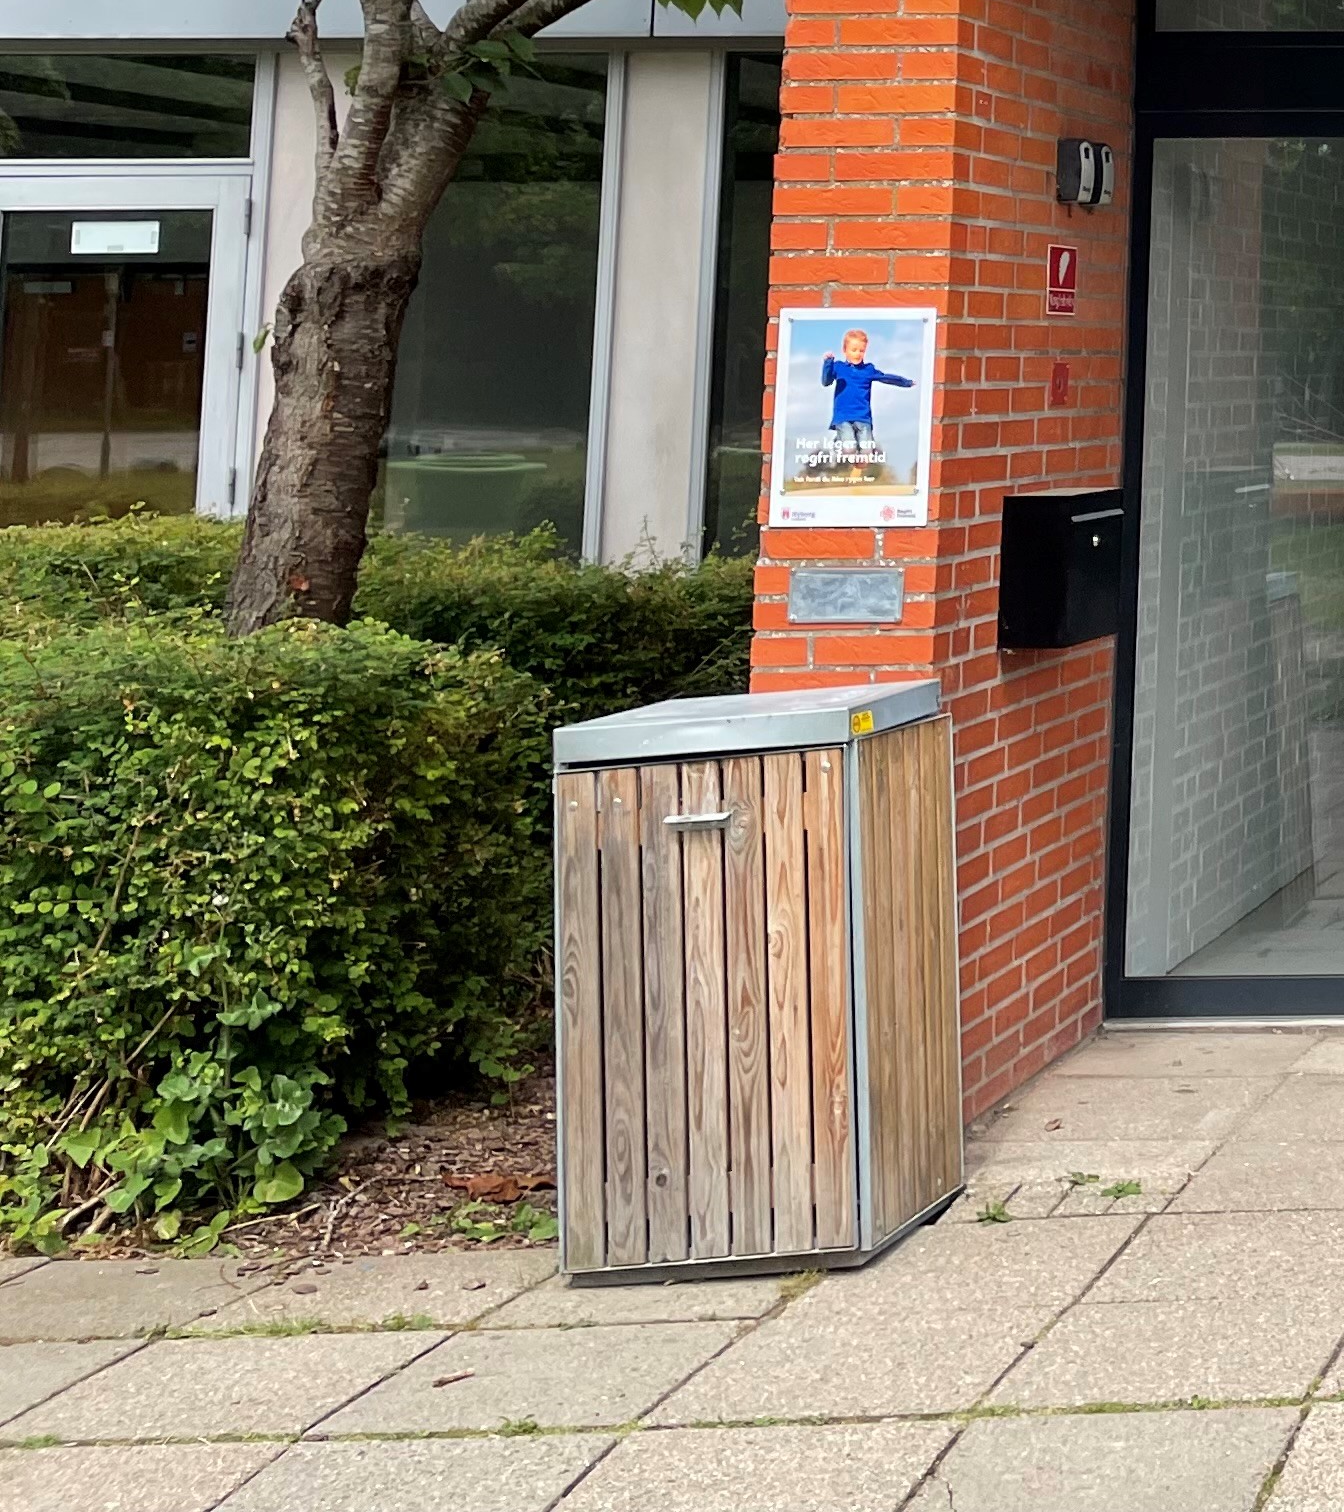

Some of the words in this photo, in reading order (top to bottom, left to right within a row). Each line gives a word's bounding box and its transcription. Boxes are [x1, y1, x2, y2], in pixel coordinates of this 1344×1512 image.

[796, 437, 820, 449] Her
[823, 437, 857, 452] leger
[859, 440, 876, 449] en
[794, 451, 833, 468] røgfri
[836, 451, 886, 464] fremtid
